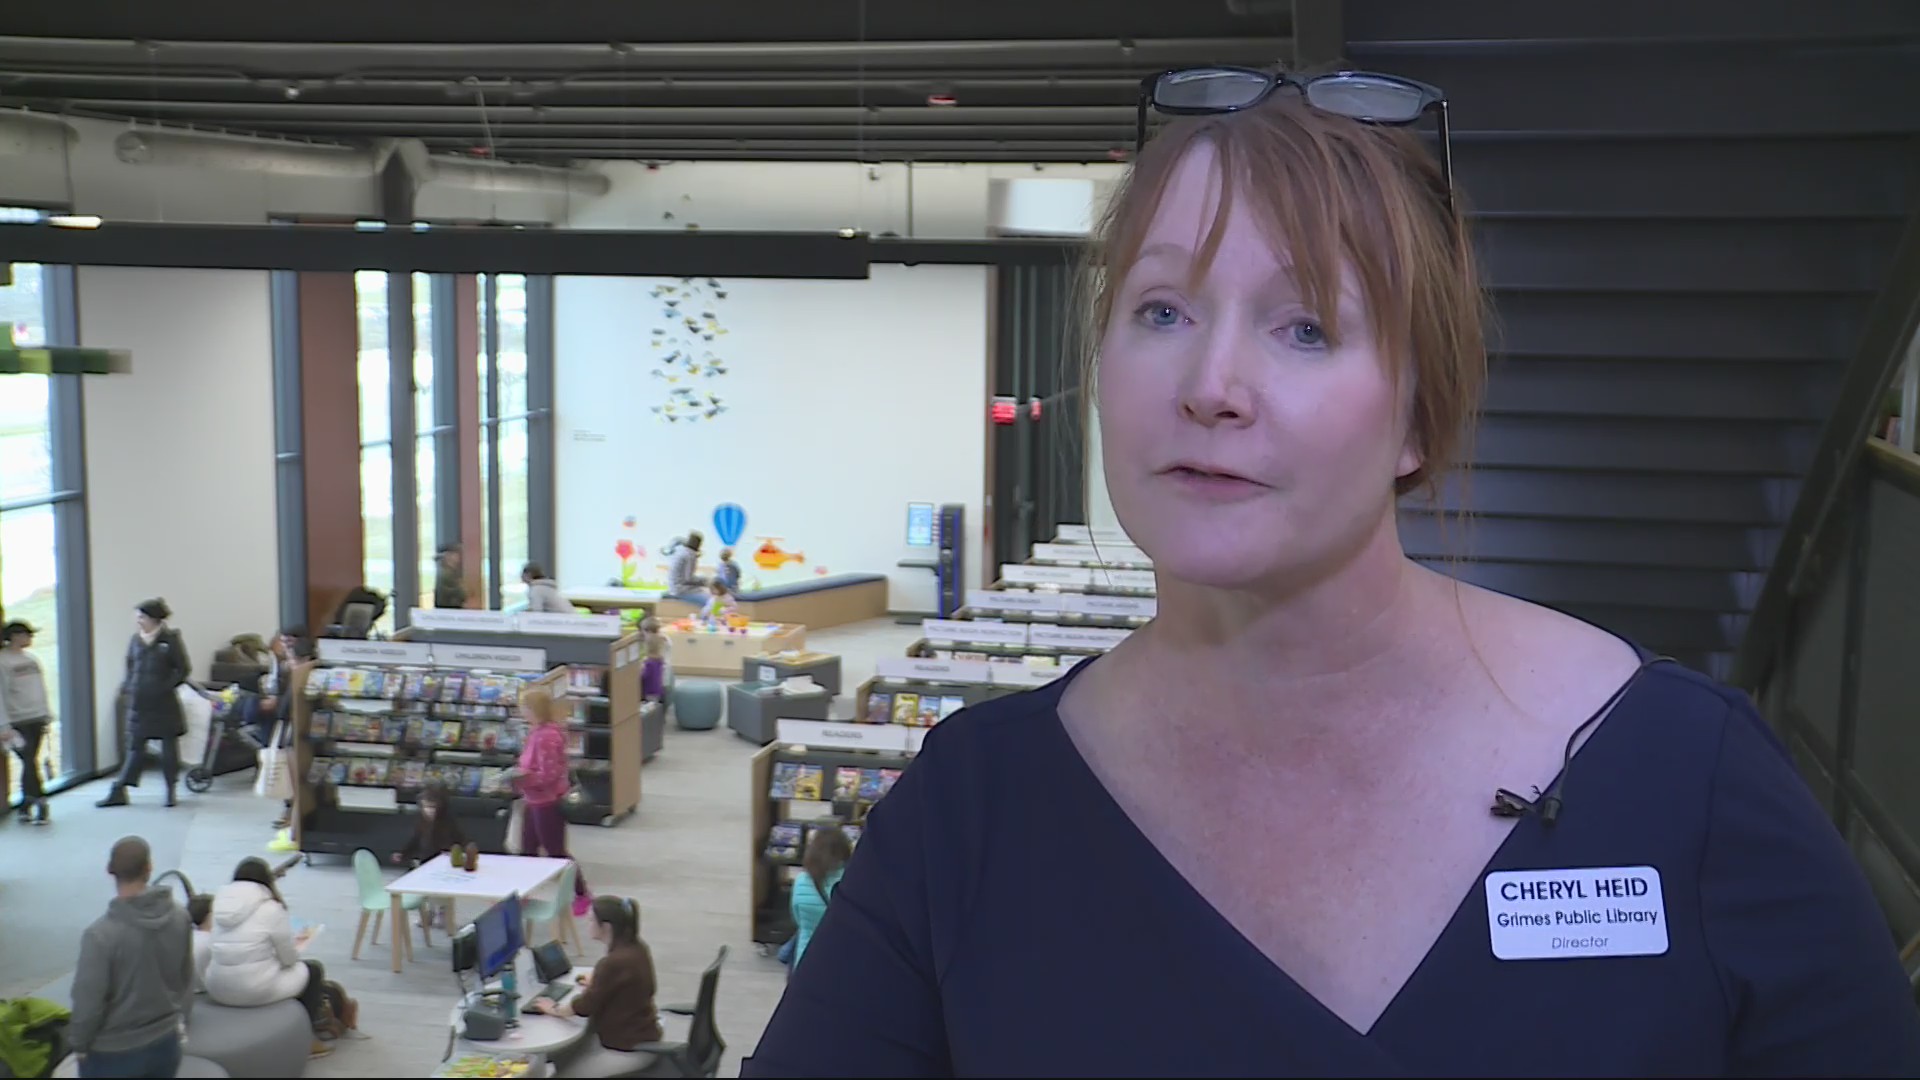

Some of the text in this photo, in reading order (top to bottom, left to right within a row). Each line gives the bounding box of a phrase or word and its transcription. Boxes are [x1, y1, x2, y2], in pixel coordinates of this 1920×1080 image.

[1500, 877, 1648, 901] CHERYL HEID
[1497, 907, 1658, 928] Grimes Public Library
[1551, 936, 1609, 950] Director
